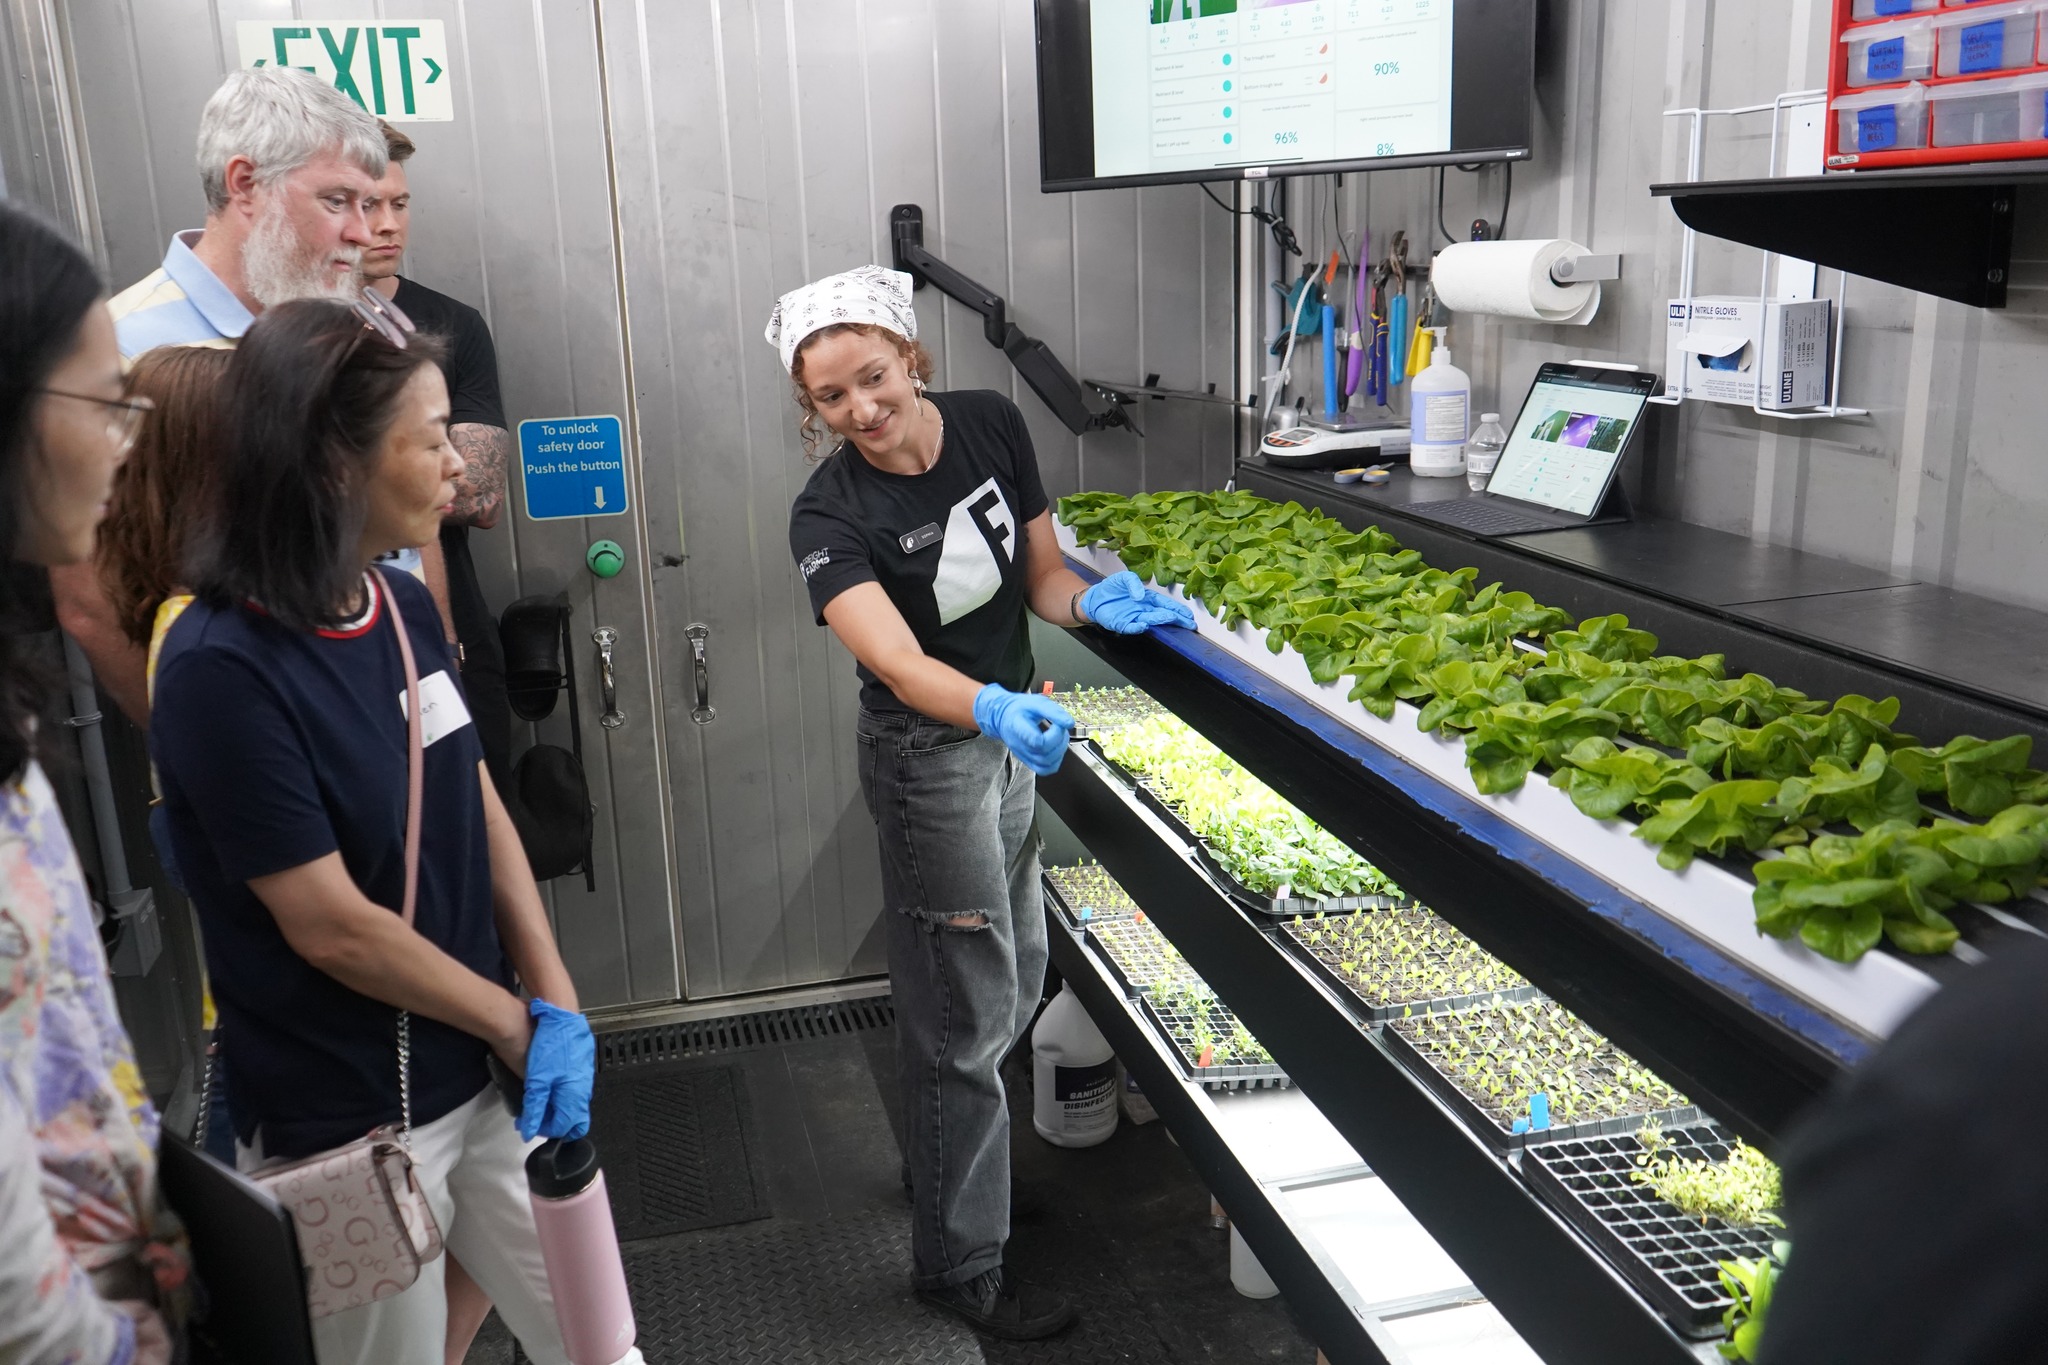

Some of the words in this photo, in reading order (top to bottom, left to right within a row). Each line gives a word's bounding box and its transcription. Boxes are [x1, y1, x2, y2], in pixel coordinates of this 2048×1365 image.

[273, 27, 420, 115] EXIT
[1374, 61, 1400, 76] 90%
[1274, 131, 1298, 145] 96%
[1376, 143, 1395, 156] 8%
[1715, 307, 1737, 316] GLOVES
[1783, 372, 1792, 402] ULINE
[541, 425, 555, 435] To
[559, 422, 598, 434] unlock
[538, 441, 573, 453] safety
[577, 440, 605, 450] door
[527, 463, 555, 474] Push
[558, 462, 578, 472] the
[580, 460, 620, 471] button
